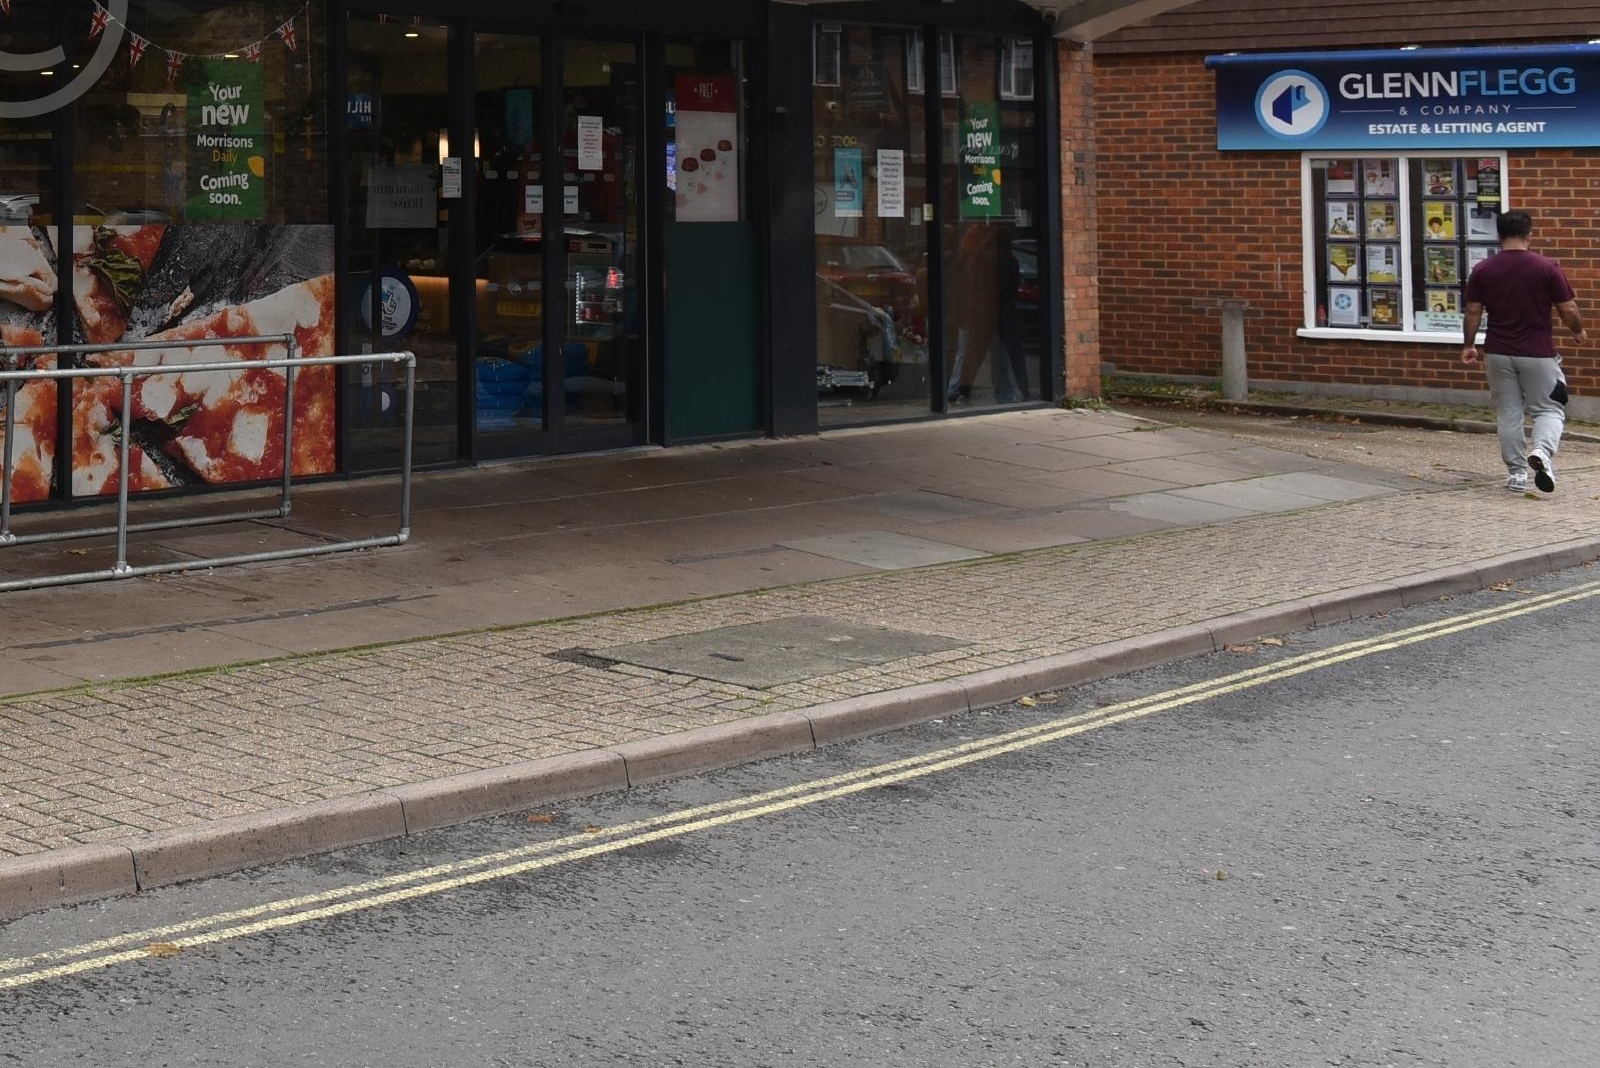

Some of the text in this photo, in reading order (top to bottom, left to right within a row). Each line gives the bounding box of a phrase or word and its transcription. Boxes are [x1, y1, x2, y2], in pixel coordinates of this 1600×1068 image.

[1339, 67, 1577, 100] GLENNFLEGG
[208, 83, 242, 101] Your
[201, 104, 250, 126] new
[1399, 104, 1512, 116] & COMPANY
[971, 119, 988, 130] Your
[1368, 121, 1546, 135] ESTATE & LETTING AGENT
[196, 134, 254, 149] Morrisons
[967, 132, 992, 148] new
[212, 150, 238, 167] Daily
[965, 154, 995, 164] Morrisons
[200, 171, 250, 191] Coming
[967, 181, 993, 195] Coming
[208, 193, 243, 206] soon.
[972, 197, 990, 205] soon.
